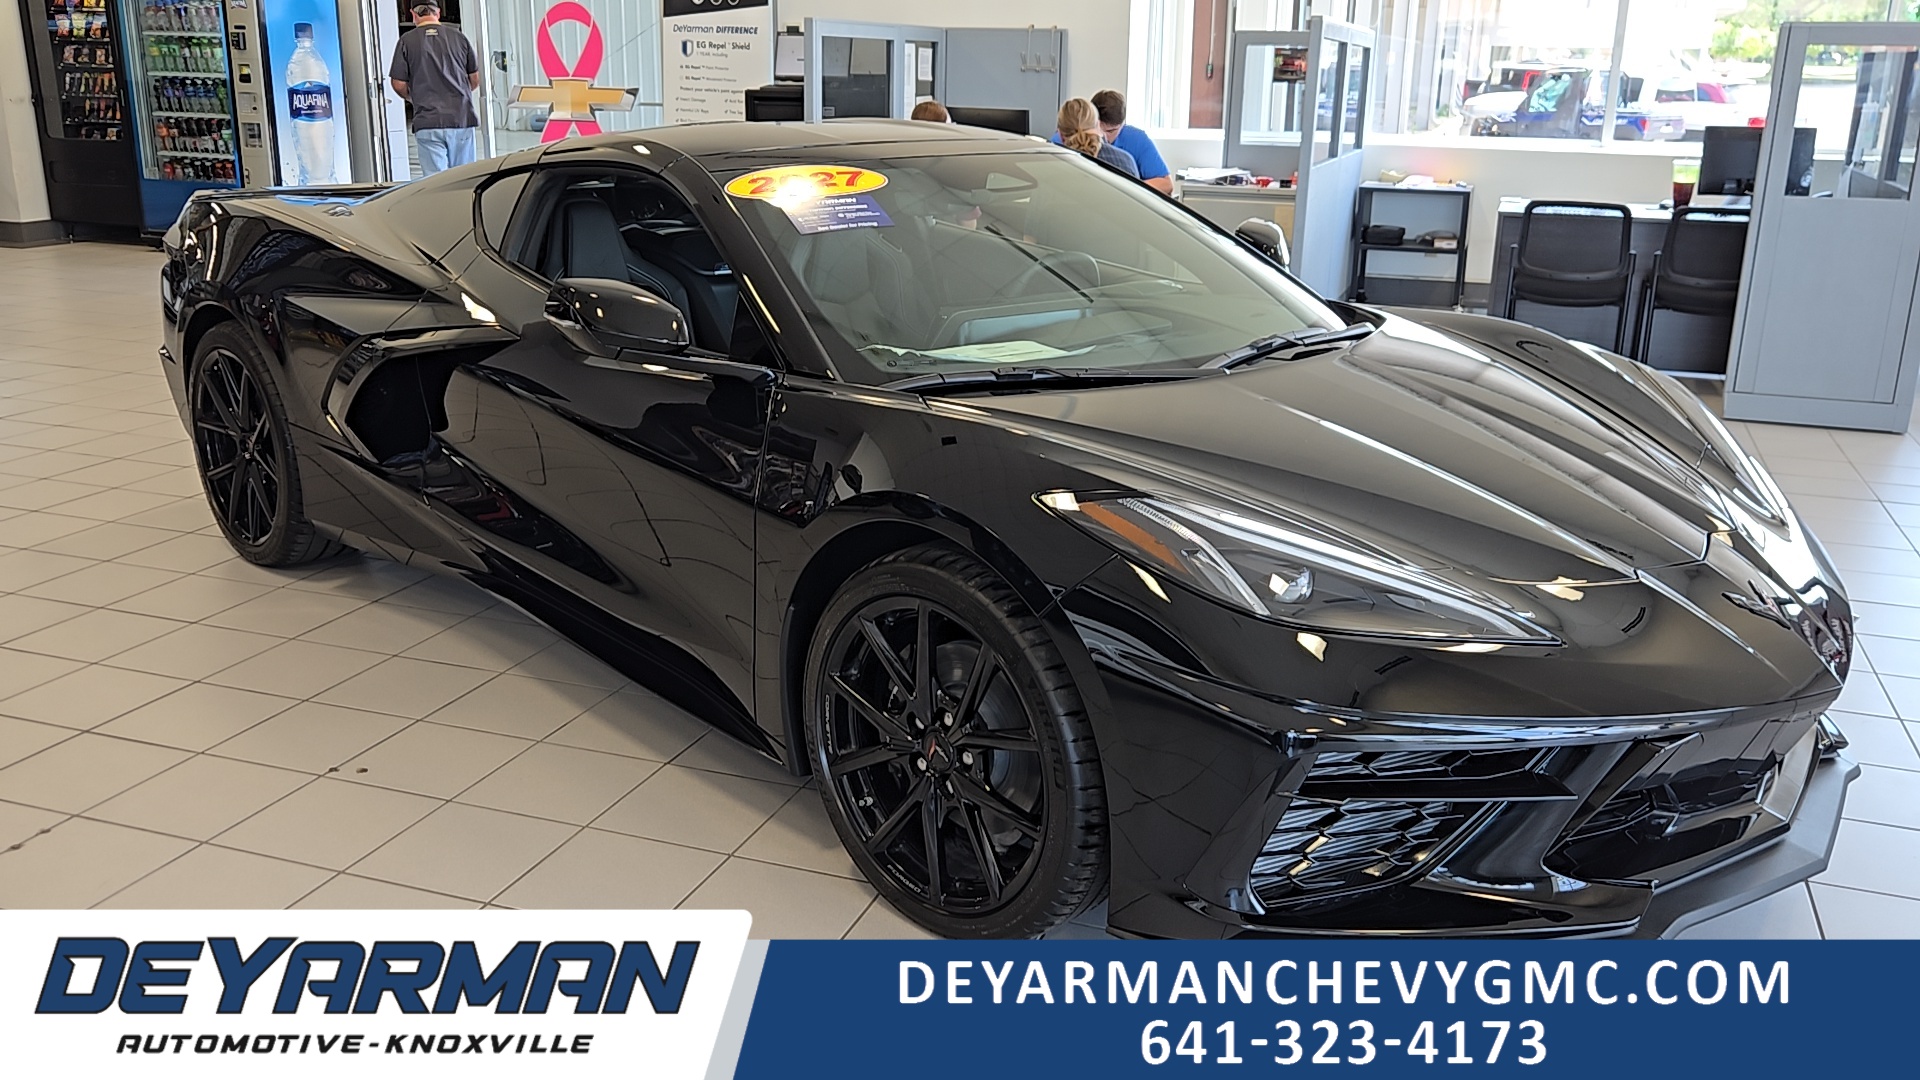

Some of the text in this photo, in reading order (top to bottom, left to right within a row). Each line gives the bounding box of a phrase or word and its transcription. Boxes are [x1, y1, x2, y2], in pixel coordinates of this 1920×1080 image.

[673, 24, 758, 35] DeYarman DIFFERENCE
[696, 40, 706, 49] EG
[731, 42, 751, 50] Shield
[293, 92, 329, 111] AQUAFINA
[748, 170, 864, 195] 227
[887, 864, 921, 893] FORGED
